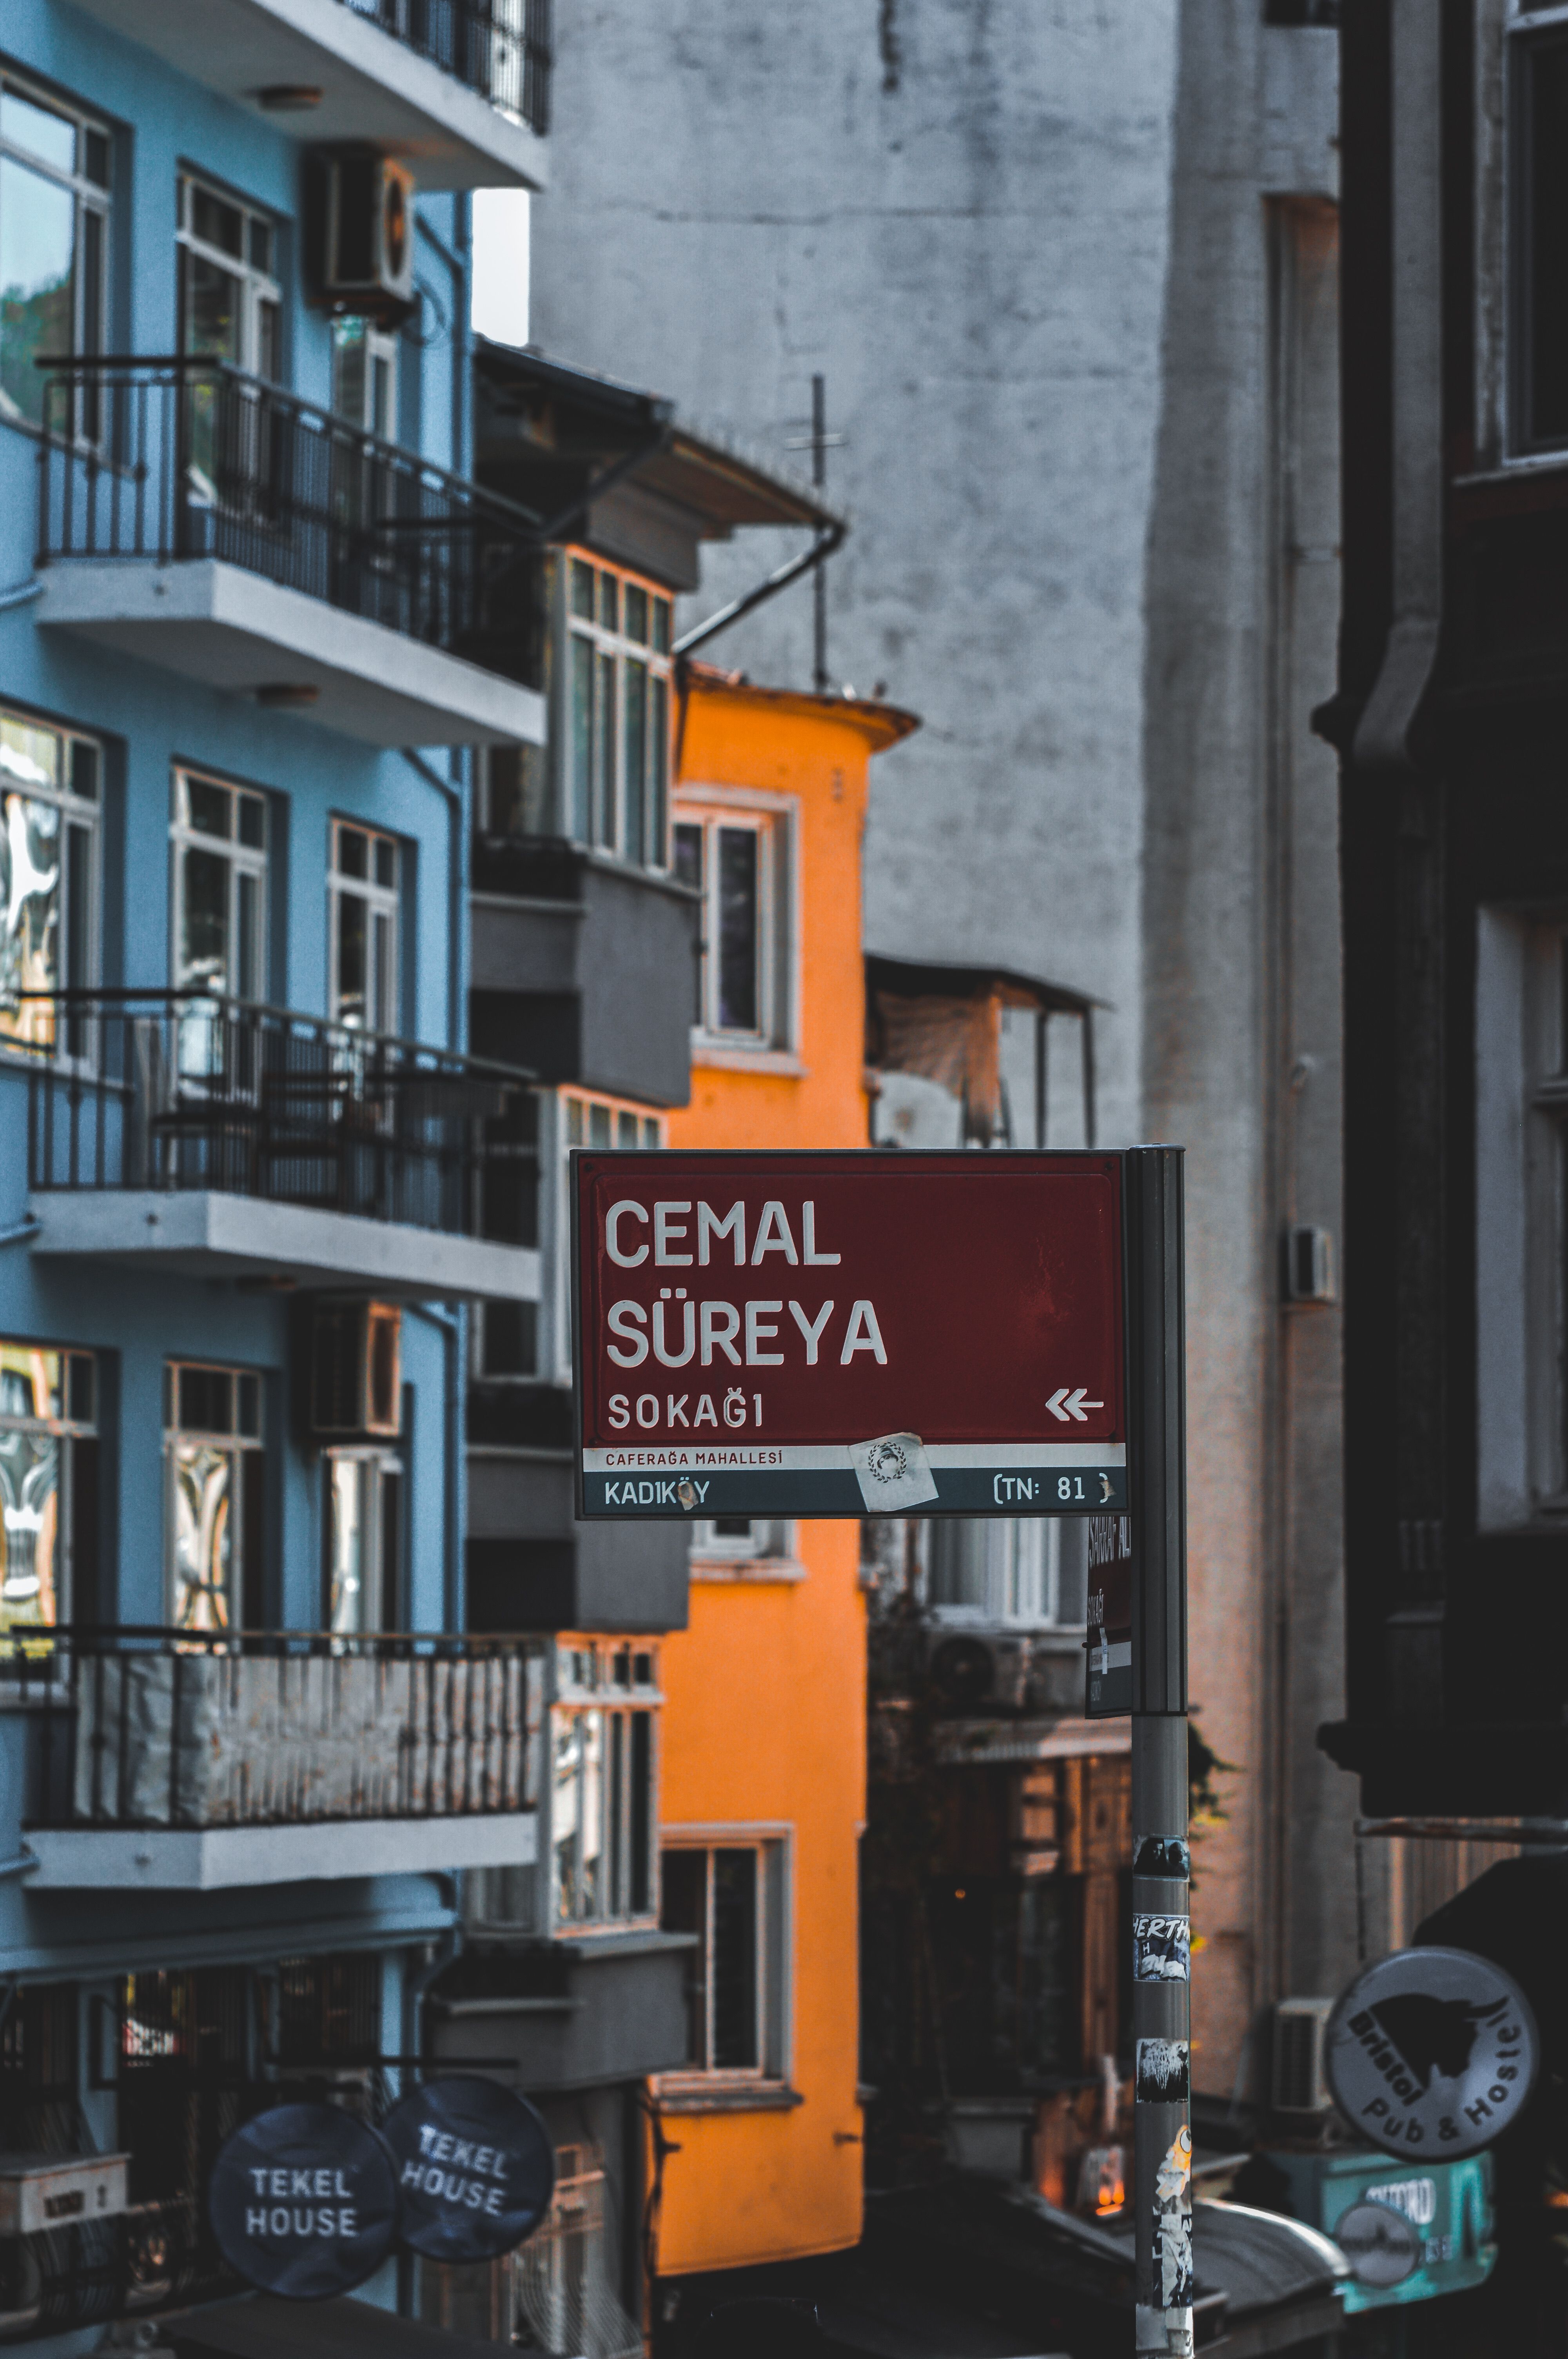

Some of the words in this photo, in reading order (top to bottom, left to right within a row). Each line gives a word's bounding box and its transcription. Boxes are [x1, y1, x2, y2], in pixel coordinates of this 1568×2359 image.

[605, 1199, 842, 1269] CEMAL
[606, 1287, 888, 1369] SÜREYA
[608, 1387, 762, 1429] SOKAĞI
[606, 1451, 689, 1466] CAFERAĞA
[695, 1449, 782, 1465] MAHALLESİ
[994, 1473, 1039, 1504] (TN:
[1058, 1476, 1085, 1499] 81
[1133, 1917, 1190, 1940] HERTH
[1347, 2010, 1424, 2106] Bristol
[1361, 2098, 1424, 2143] Pub
[1438, 2117, 1460, 2141] &
[1463, 2011, 1521, 2126] Hostel
[418, 2124, 508, 2180] TEKEL
[250, 2168, 354, 2198] TEKEL
[400, 2159, 506, 2217] HOUSE
[246, 2208, 358, 2238] HOUSE
